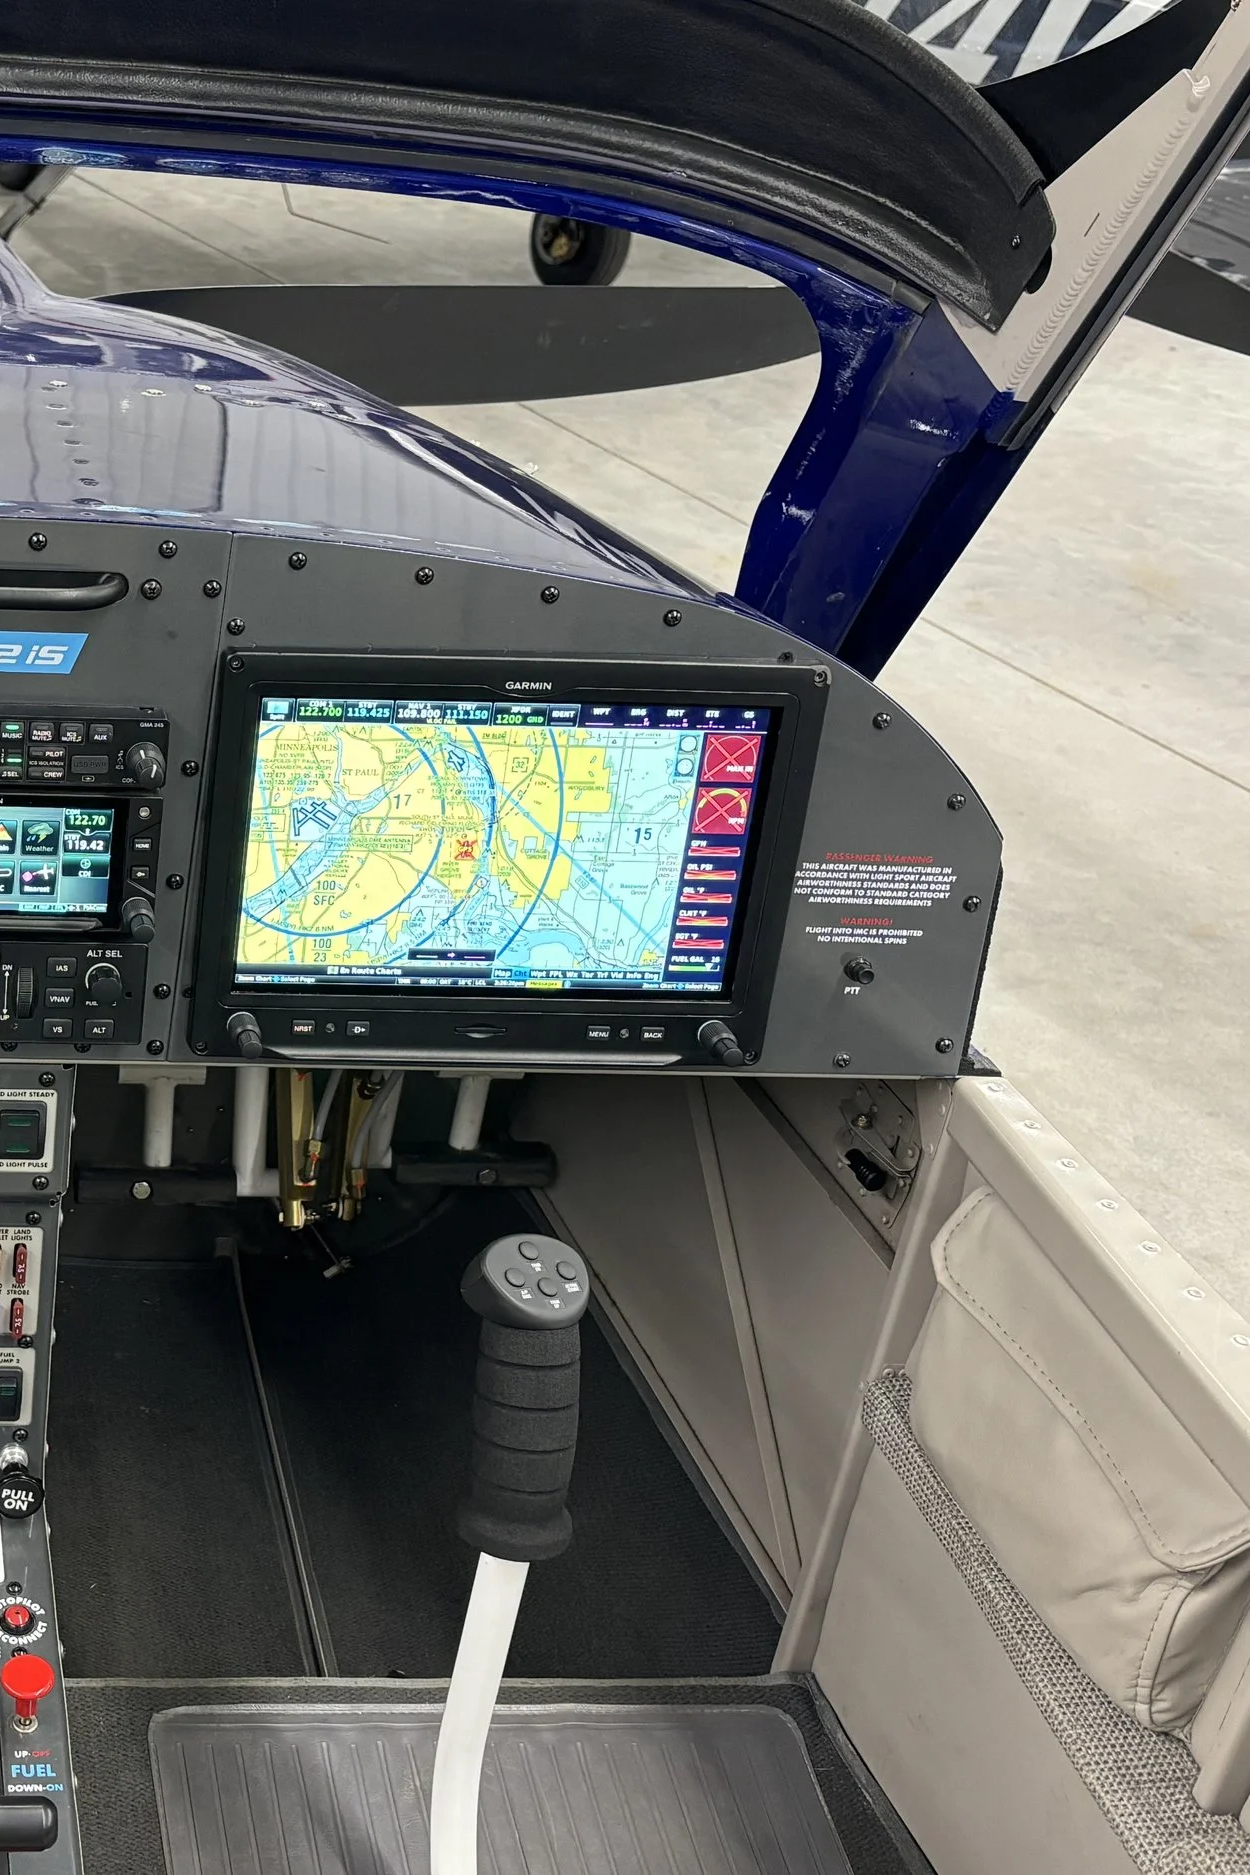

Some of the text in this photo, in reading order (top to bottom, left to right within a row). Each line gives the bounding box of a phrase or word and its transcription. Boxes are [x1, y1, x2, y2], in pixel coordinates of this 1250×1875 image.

[505, 681, 552, 691] GARMIN
[299, 707, 342, 716] 122.700
[347, 708, 390, 717] 119.425
[397, 709, 440, 718] 109.800
[446, 710, 488, 719] 111.150
[275, 743, 338, 752] MINNEAPOLIS
[357, 768, 379, 776] PAUL
[394, 794, 412, 809] 17
[69, 816, 105, 825] 122.70
[634, 827, 652, 843] 15
[68, 840, 103, 850] 119.42
[825, 852, 934, 863] PASSENGER WARNING
[878, 865, 941, 873] MANUFACTURED
[317, 880, 336, 890] 100
[797, 880, 861, 888] AIRWORTHINESS
[863, 881, 909, 889] STANDARDS
[910, 882, 928, 890] AND
[866, 890, 908, 898] STANDARD
[909, 891, 950, 899] CATEGORY
[314, 895, 335, 905] SFC
[808, 896, 932, 906] AIRWORTHINESS REQUIREMENTS
[840, 918, 892, 926] WARNING!
[312, 939, 331, 948] 100
[314, 952, 327, 962] 23
[644, 1031, 662, 1039] BACK
[1, 1489, 34, 1502] PULL
[4, 1499, 28, 1511] ON
[11, 1765, 56, 1777] FUEL
[8, 1784, 63, 1792] DOWN-ON
